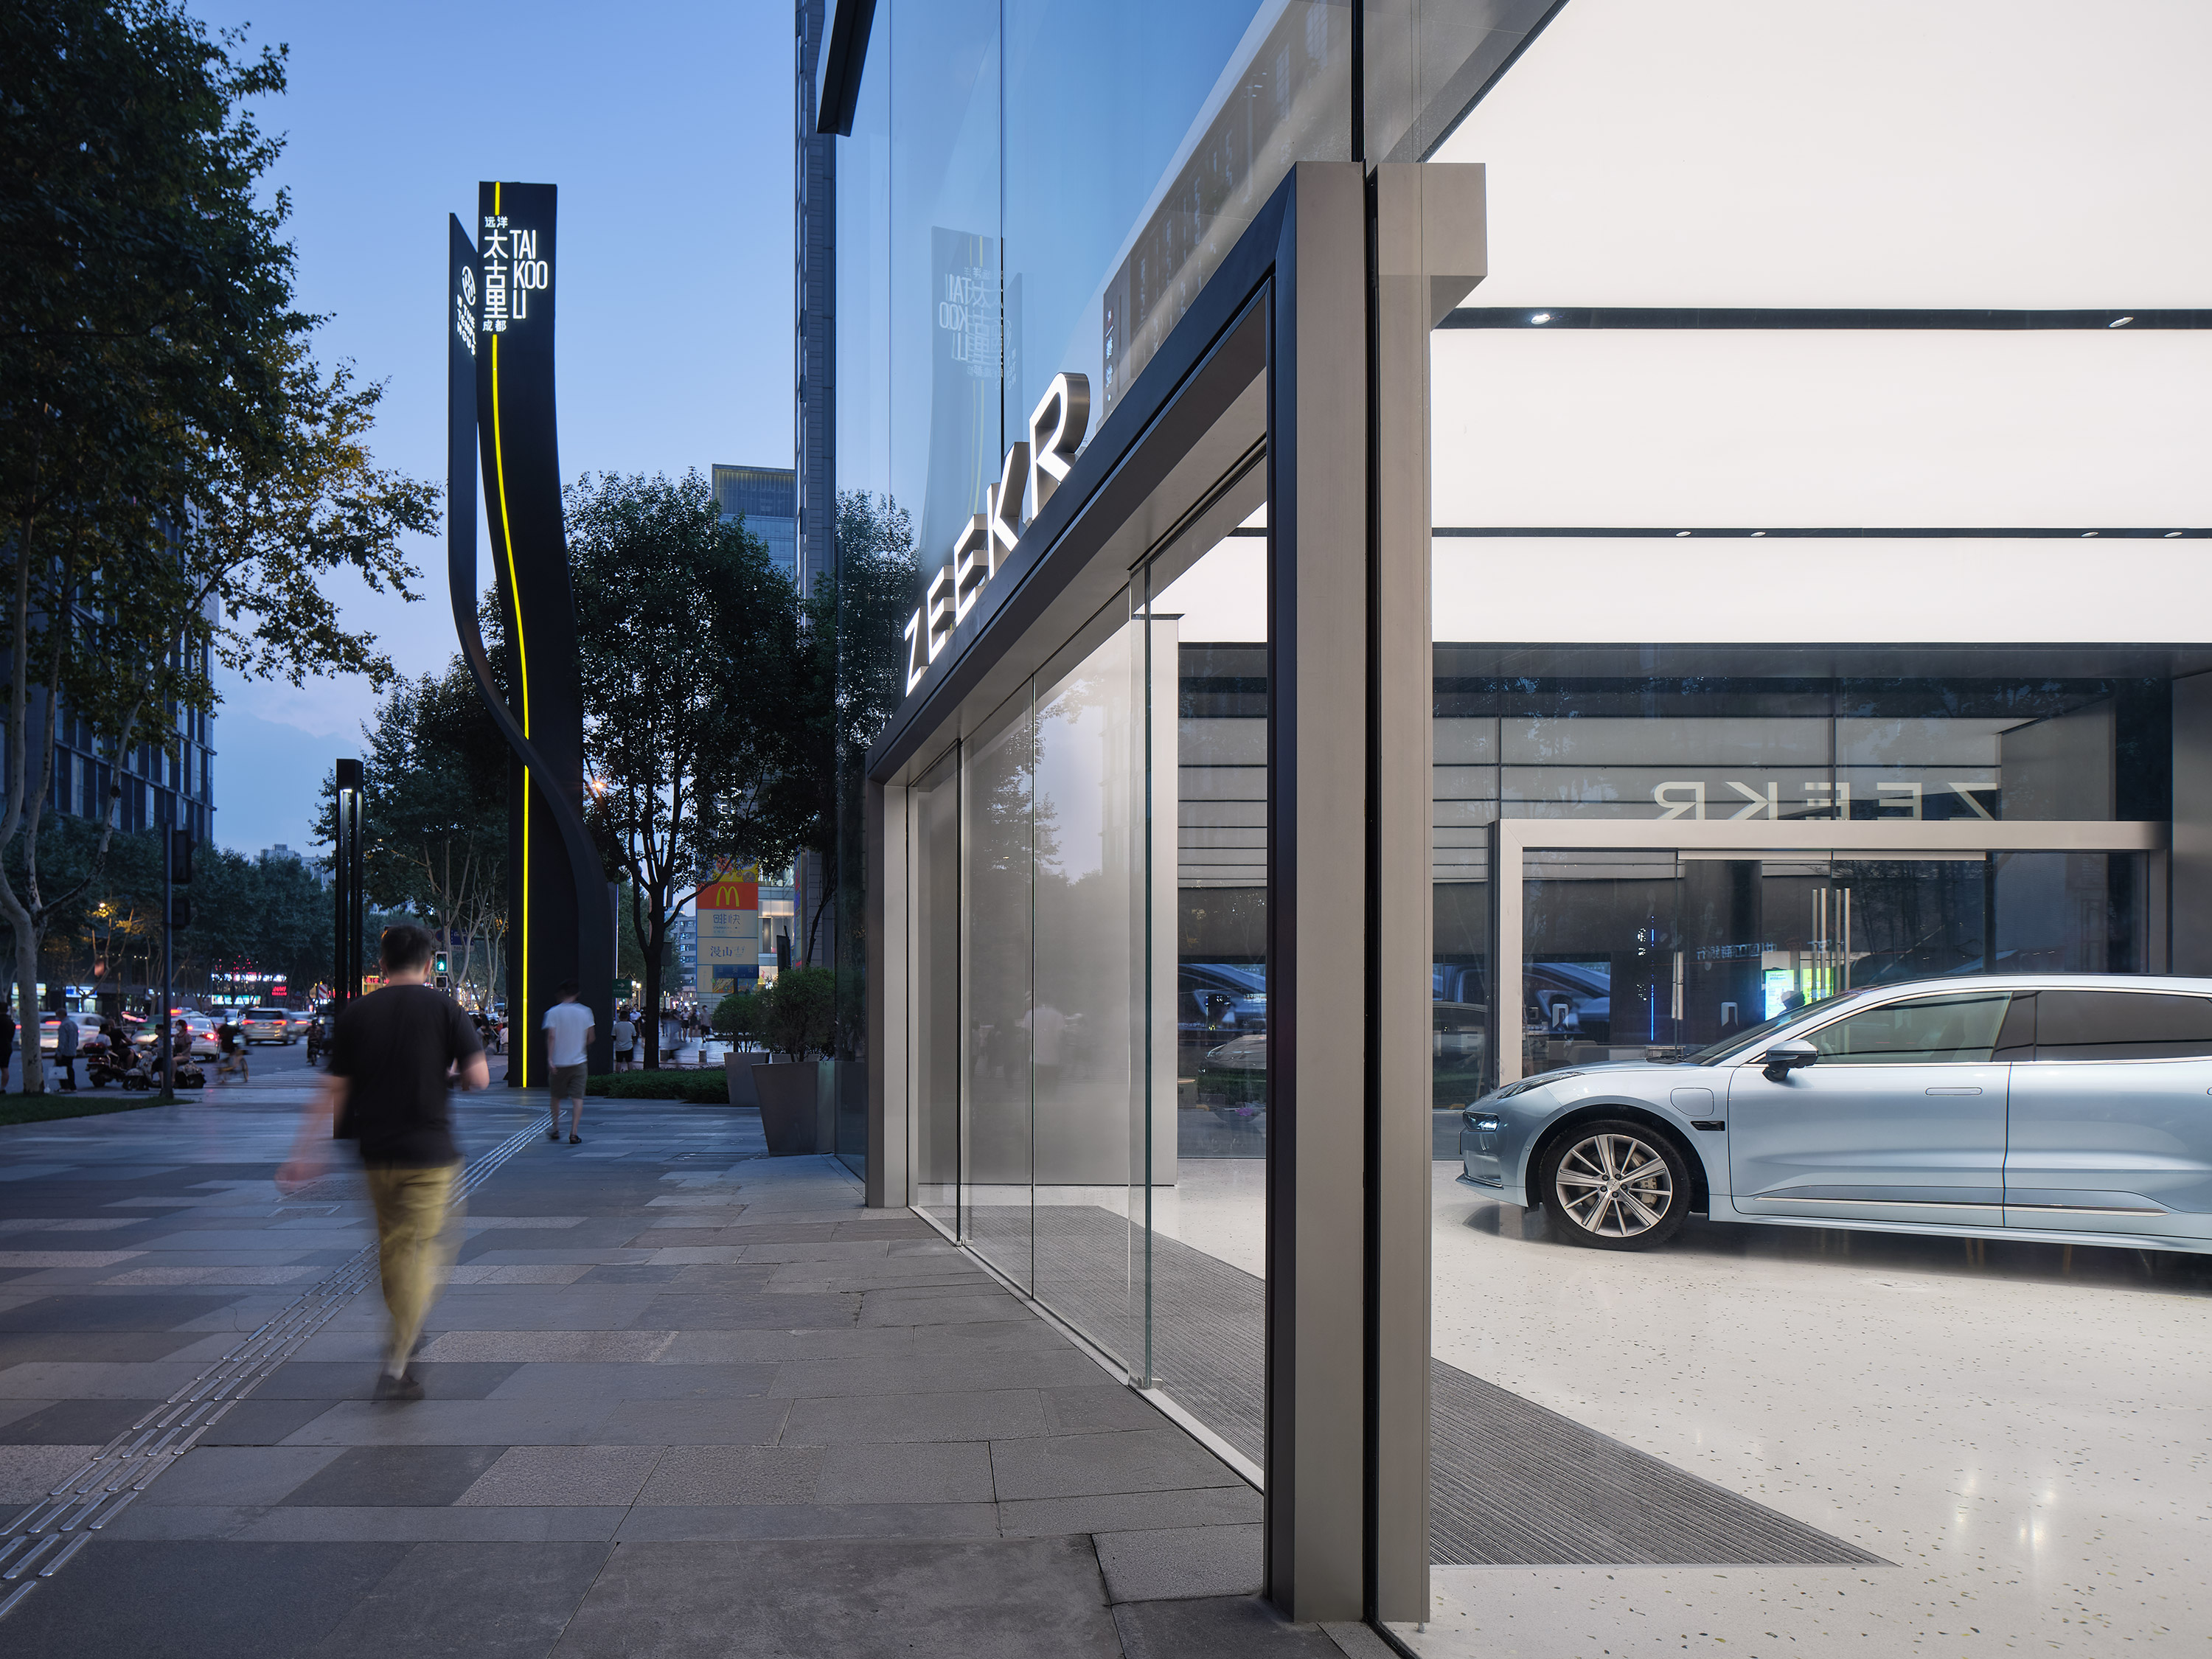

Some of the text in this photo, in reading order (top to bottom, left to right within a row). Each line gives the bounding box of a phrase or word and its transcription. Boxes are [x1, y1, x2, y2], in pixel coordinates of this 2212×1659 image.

[484, 216, 509, 229] 远洋
[509, 229, 537, 260] TAI
[483, 229, 509, 319] 太古里
[513, 260, 549, 290] KOO
[463, 303, 476, 329] THE
[512, 289, 526, 319] LI
[482, 319, 507, 332] 成都
[904, 372, 1091, 698] ZEEKR
